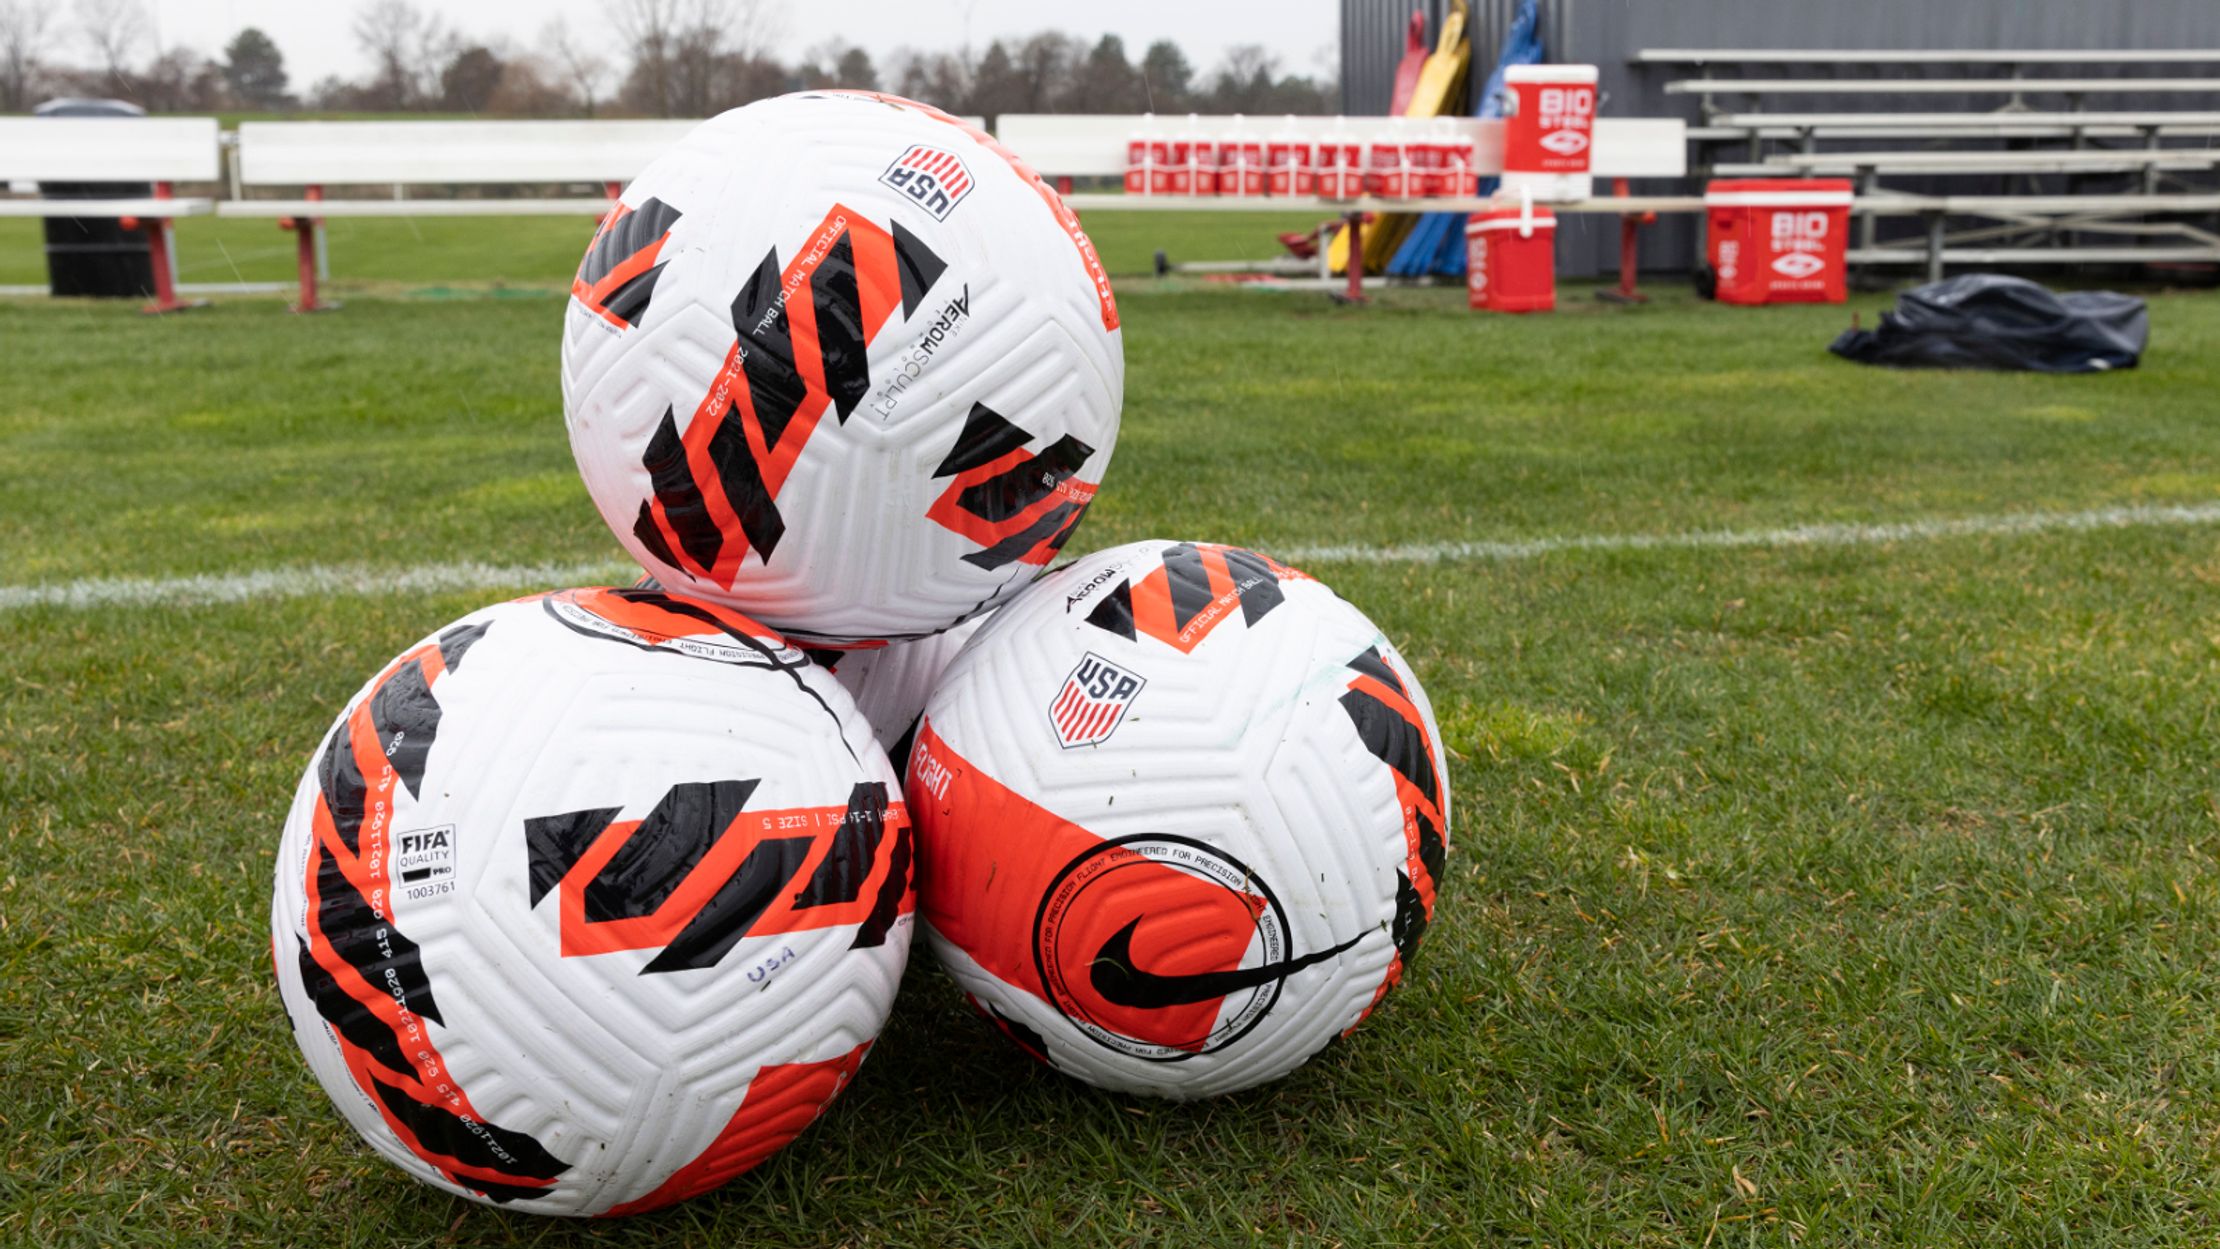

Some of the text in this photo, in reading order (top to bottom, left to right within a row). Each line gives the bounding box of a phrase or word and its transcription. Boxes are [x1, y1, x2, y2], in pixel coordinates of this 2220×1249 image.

[1539, 88, 1593, 115] BIO
[887, 167, 949, 215] USA
[1771, 211, 1829, 238] BIO
[753, 215, 847, 336] OFFICIAL MATCH BALL
[705, 345, 749, 416] 2021-2022
[1179, 606, 1221, 643] OFFICIAL
[680, 642, 715, 656] FLIGHT
[1077, 657, 1139, 700] USA
[386, 731, 405, 757] 920
[378, 764, 393, 792] 415
[762, 817, 772, 830] 5
[778, 815, 808, 829] SIZE
[369, 801, 385, 879] 10211920
[400, 850, 449, 867] QUALITY
[433, 866, 452, 875] PRO
[1076, 858, 1106, 882] FLIGHT
[1111, 846, 1168, 862] ENGINEERED
[1172, 849, 1191, 860] FOR
[1195, 855, 1242, 886] PRECISION
[372, 888, 385, 920] 920
[407, 881, 455, 900] 1003761
[376, 928, 393, 958] 415
[747, 946, 795, 982] USA
[384, 968, 421, 1043] 10211920
[418, 1050, 439, 1077] 920
[436, 1083, 460, 1106] 415
